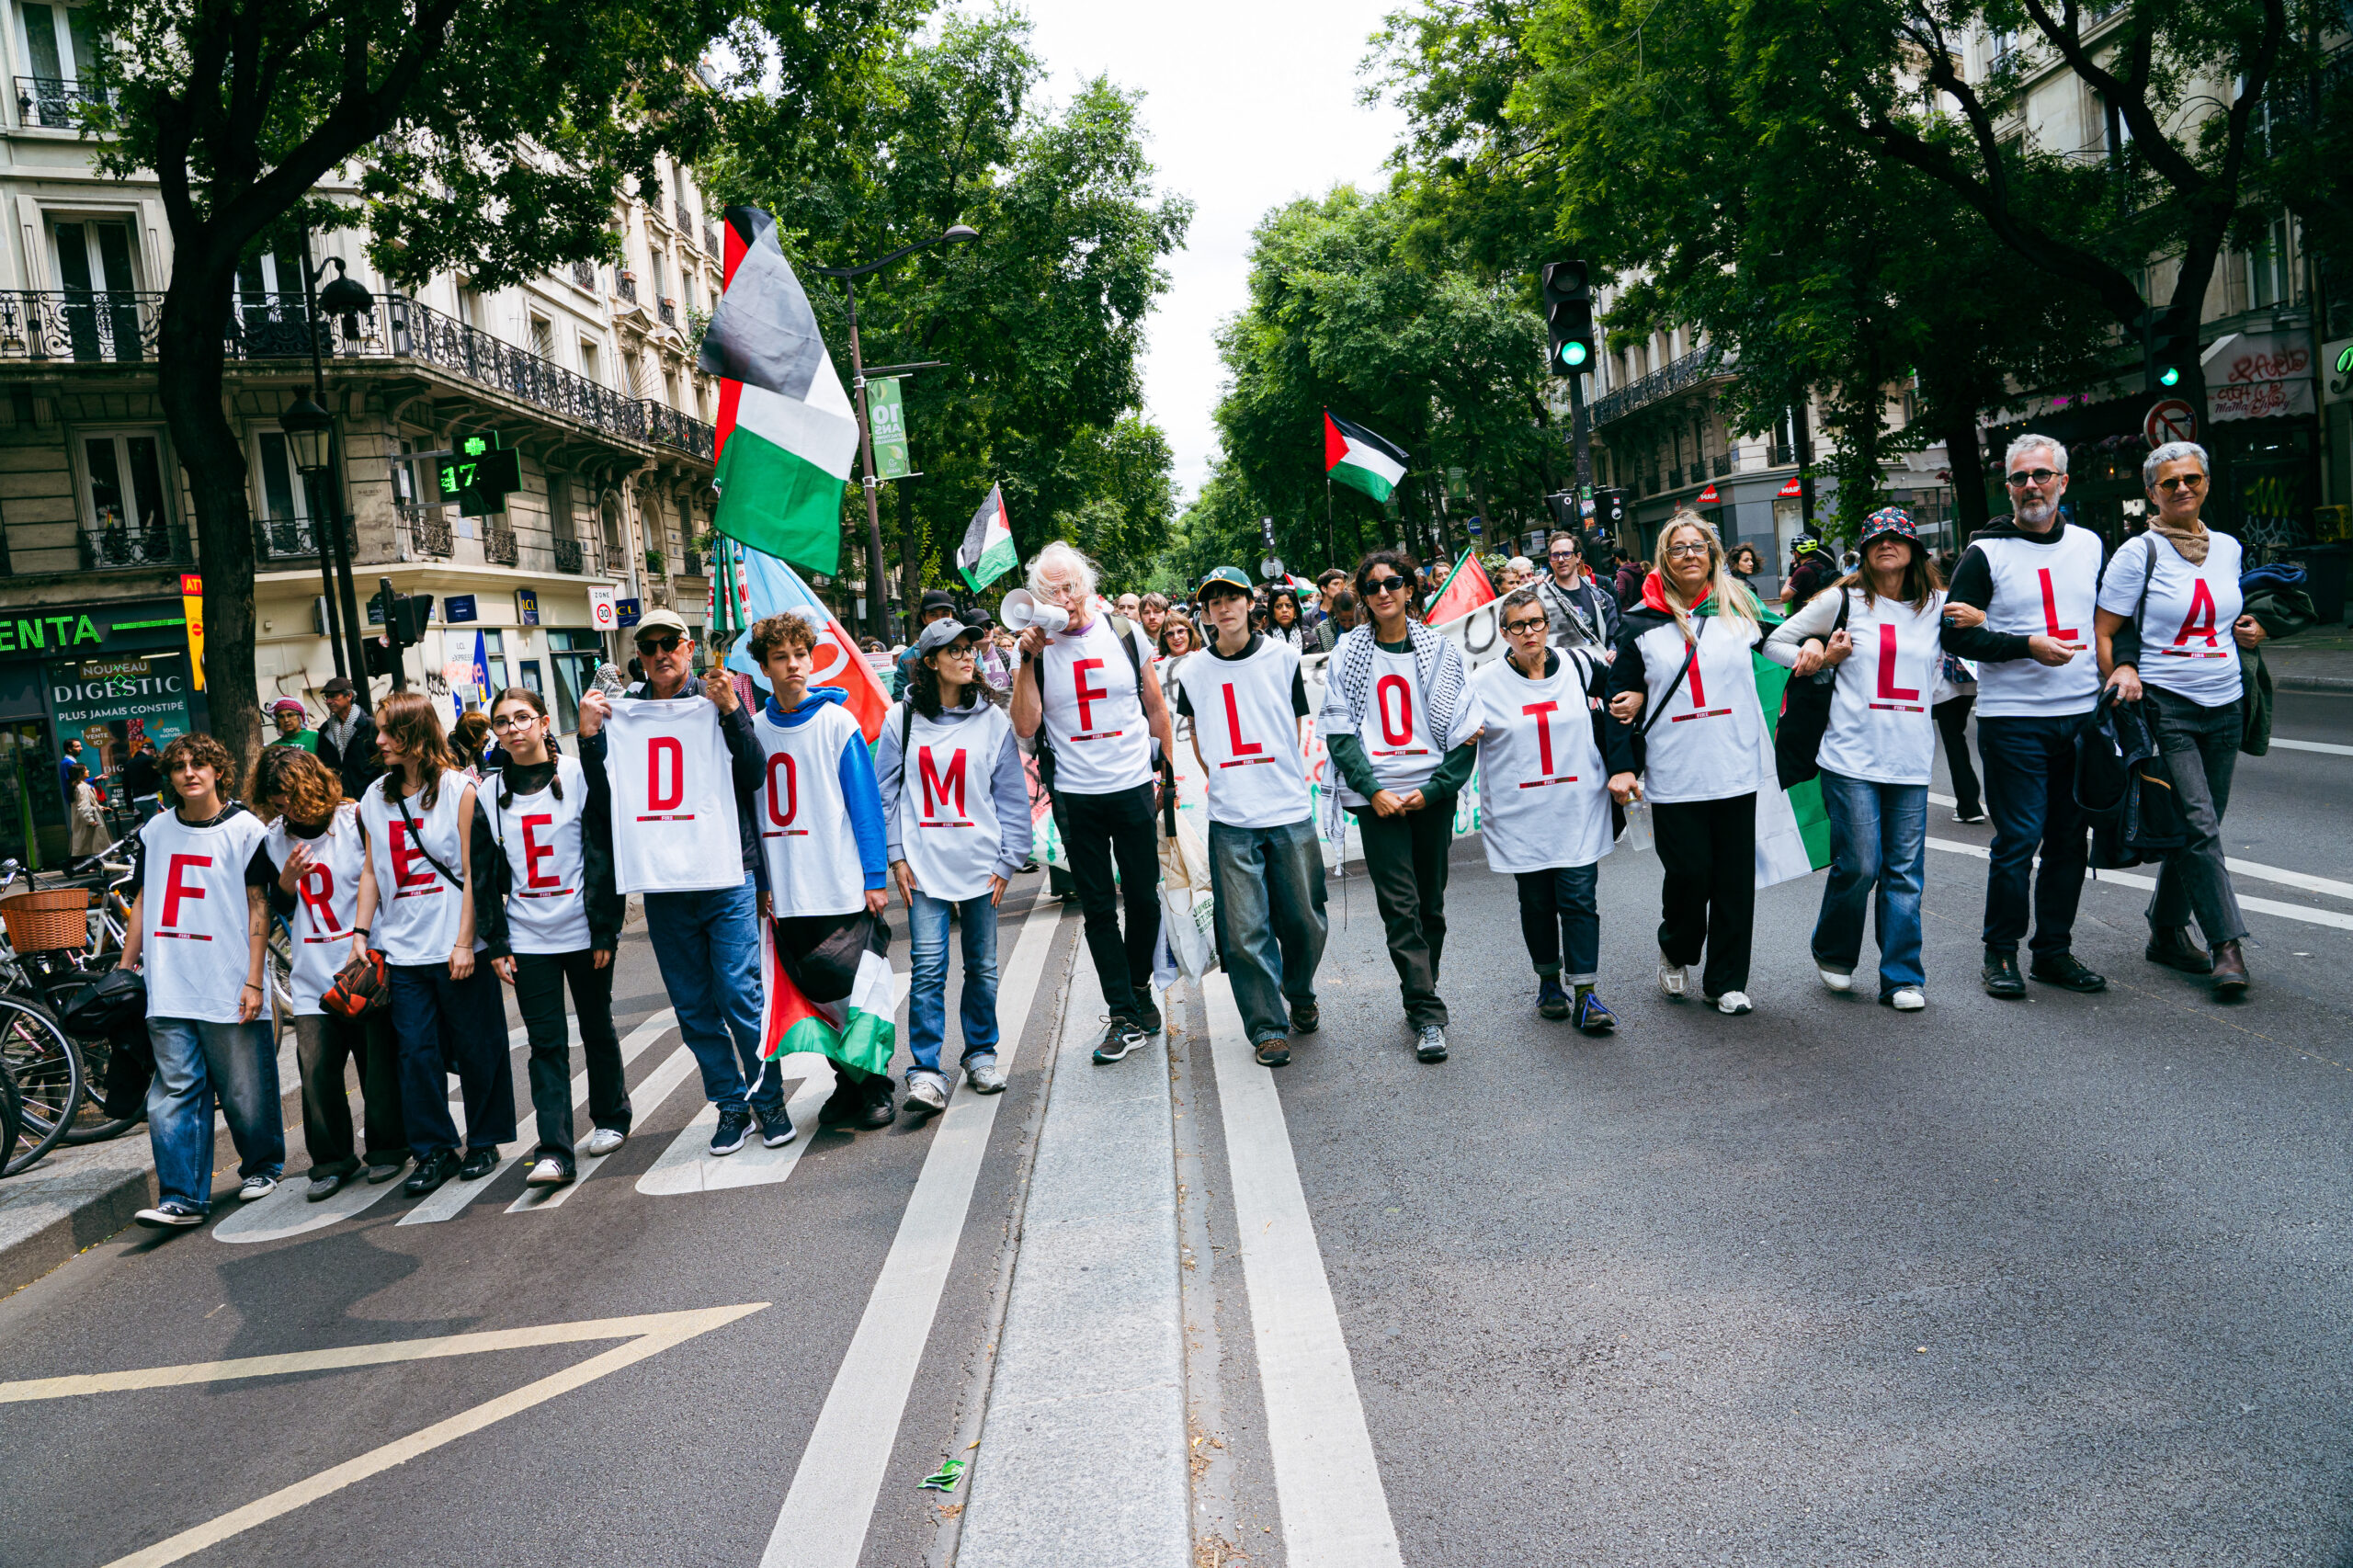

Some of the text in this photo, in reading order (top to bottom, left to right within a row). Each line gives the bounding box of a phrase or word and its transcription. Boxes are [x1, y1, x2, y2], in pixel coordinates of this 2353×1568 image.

[441, 463, 477, 493] 17
[1781, 485, 1801, 494] MAIF
[522, 599, 537, 610] LCL
[599, 608, 609, 618] 30
[2038, 568, 2078, 641] L
[2174, 578, 2218, 647] A
[83, 661, 148, 676] NOUVEAU
[456, 642, 466, 650] LCL
[1686, 640, 1706, 708] I
[1877, 623, 1919, 701] L
[53, 676, 182, 703] DIGESTIC
[58, 701, 184, 722] PLUS JAMAIS CONSTIPÉ
[1073, 658, 1108, 732] F
[1222, 683, 1263, 756] L
[1377, 674, 1413, 746] O
[648, 736, 683, 811] D
[1522, 700, 1559, 776] T
[767, 752, 797, 827] O
[919, 745, 967, 818] M
[389, 818, 436, 889] E
[522, 813, 561, 889] E
[162, 854, 212, 927] F
[300, 863, 342, 933] R
